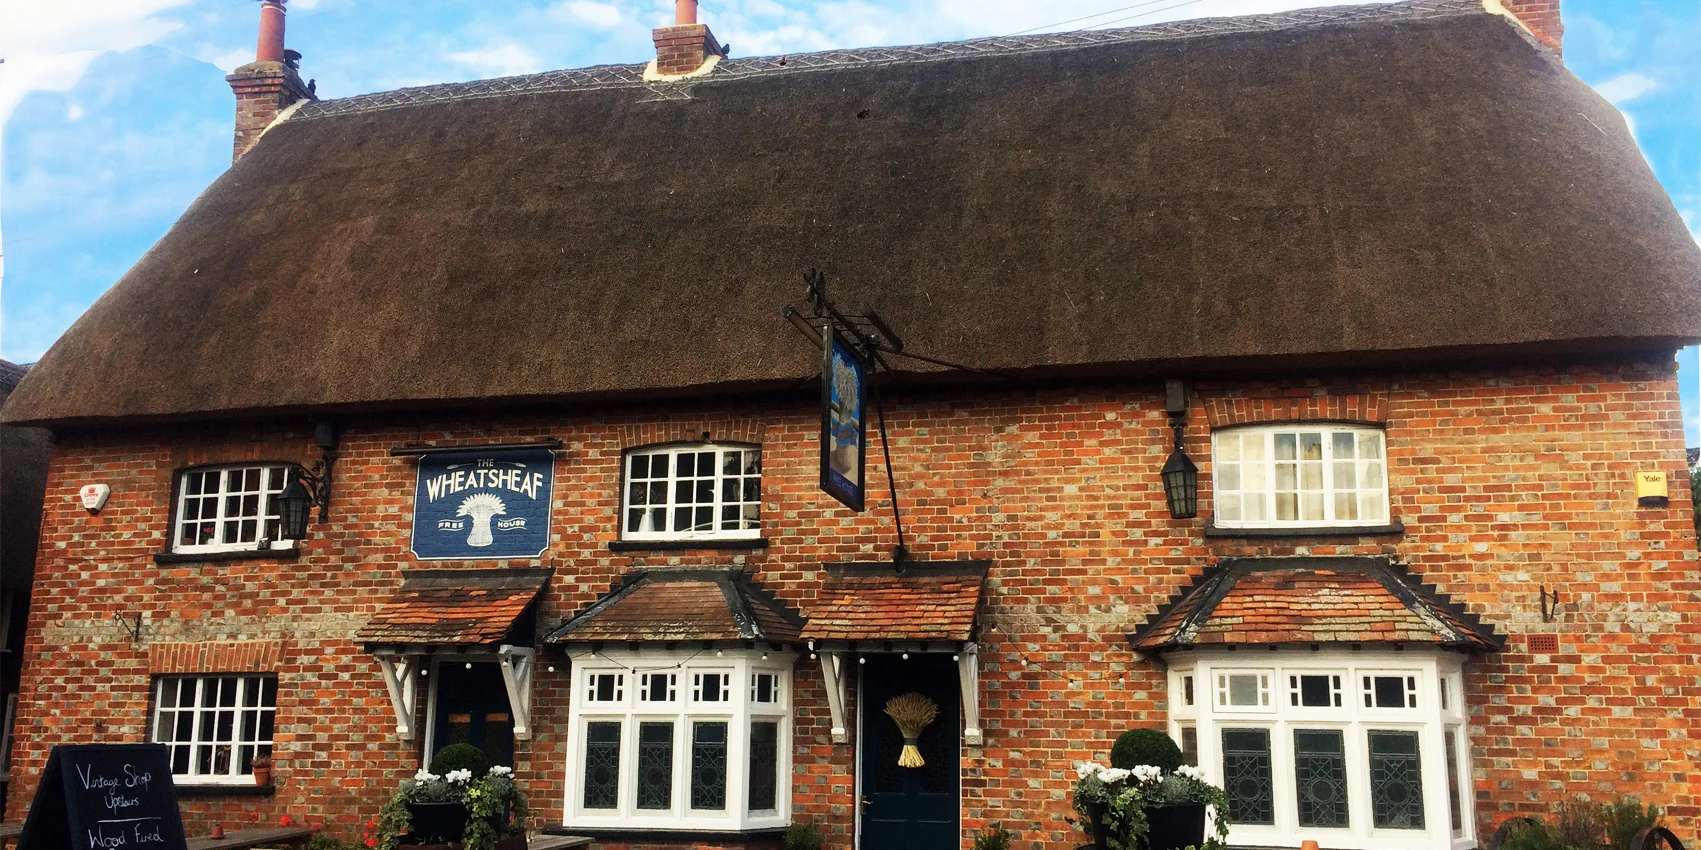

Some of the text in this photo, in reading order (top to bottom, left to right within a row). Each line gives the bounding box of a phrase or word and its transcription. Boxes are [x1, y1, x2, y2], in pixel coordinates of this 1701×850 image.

[477, 458, 495, 468] THE
[426, 469, 544, 504] WHEATSHEAF
[1643, 475, 1661, 483] Yale
[438, 520, 526, 529] FREE HOUSE
[76, 763, 152, 795] Vintage Shop
[104, 794, 140, 815] Upstairs
[88, 823, 164, 849] Wood Fired
